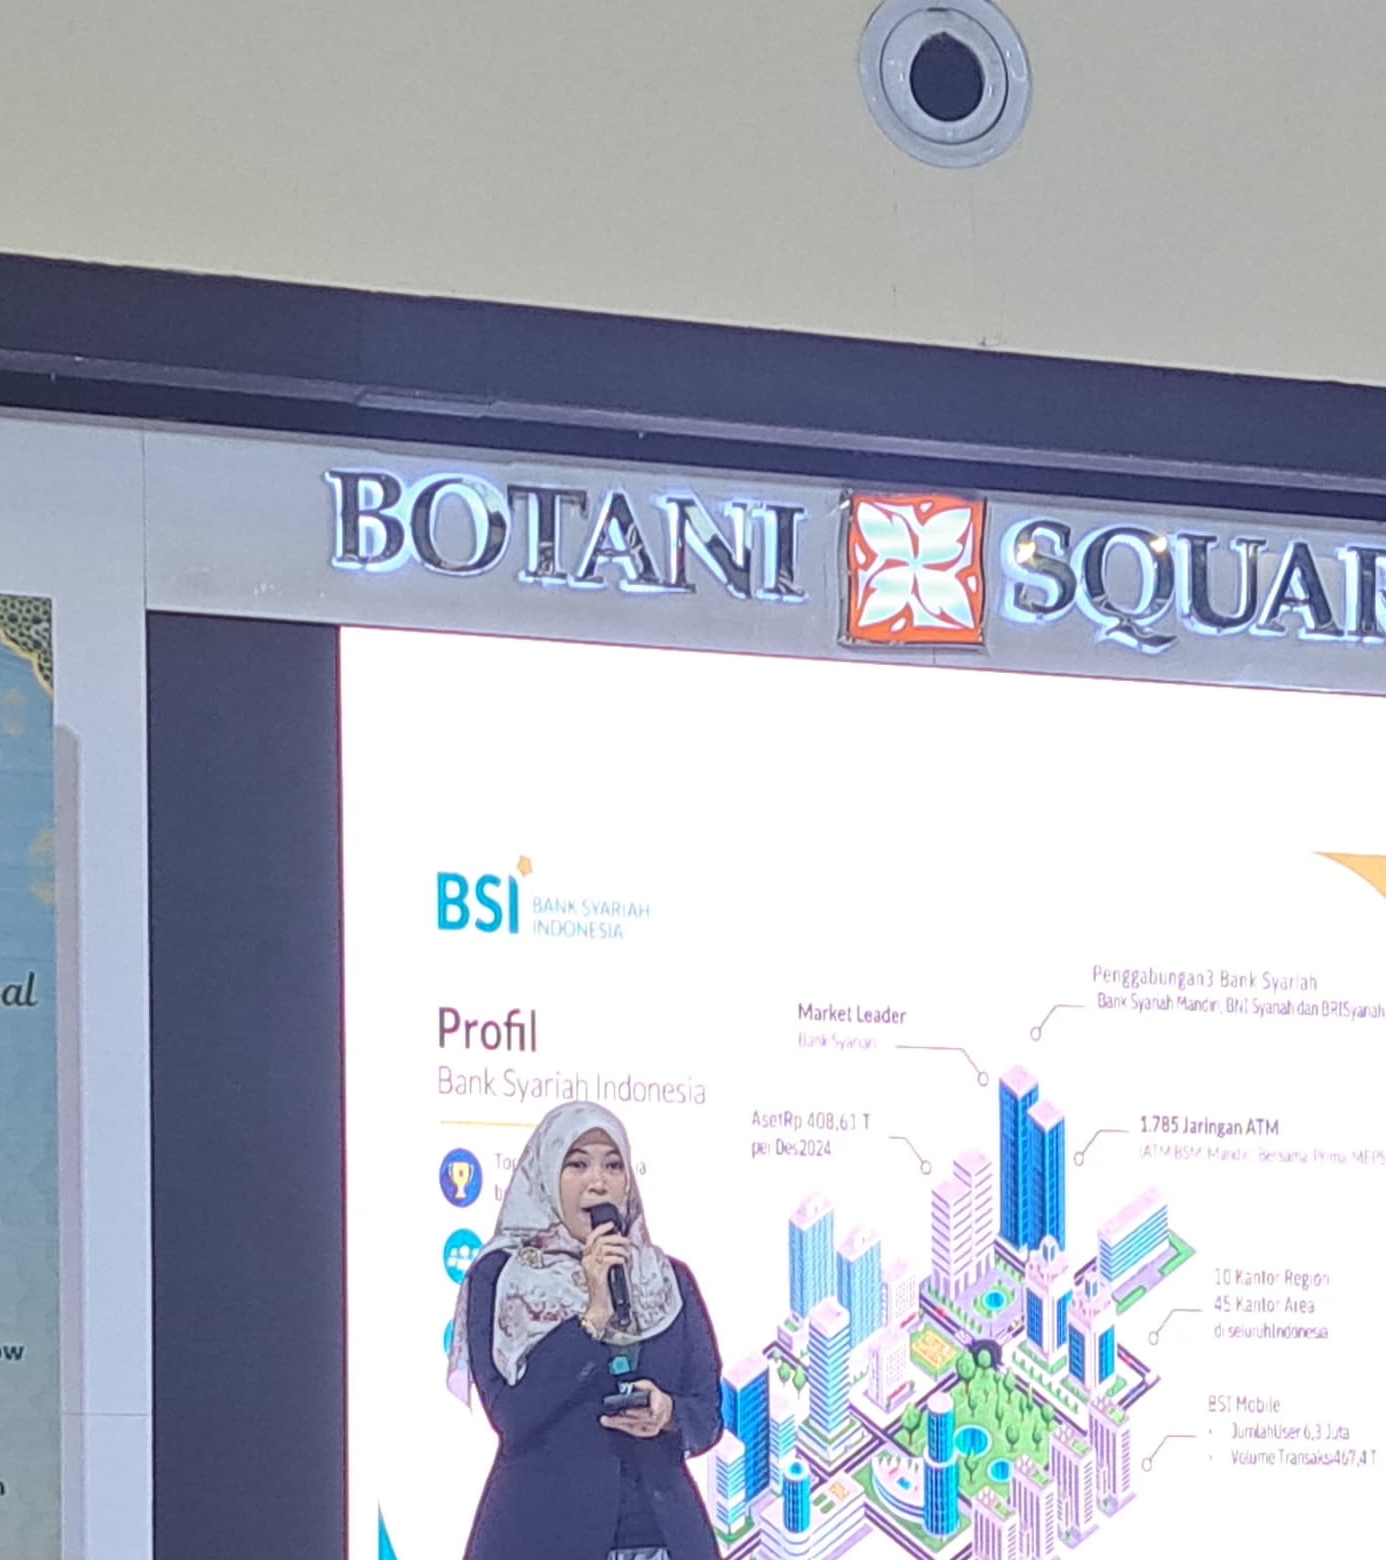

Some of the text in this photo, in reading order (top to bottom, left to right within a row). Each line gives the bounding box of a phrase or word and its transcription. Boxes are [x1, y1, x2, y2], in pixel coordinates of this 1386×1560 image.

[324, 469, 809, 602] BOTANI
[436, 871, 520, 935] BSI
[532, 895, 578, 916] BANK
[532, 918, 625, 941] INDONESIA
[1220, 969, 1258, 989] Bank
[798, 1002, 908, 1025] Market Leader
[1097, 991, 1127, 1010] Bank
[1296, 1000, 1319, 1016] dan
[438, 1006, 538, 1053] Profil
[438, 1065, 707, 1105] Bank Syariah Indonesia
[1140, 1116, 1280, 1138] 1.785 Jaringan ATM
[1214, 1268, 1331, 1291] 10 Kantor Region
[1214, 1295, 1232, 1313] 45
[1235, 1296, 1281, 1313] Kantor
[1236, 1395, 1282, 1414] Mobile
